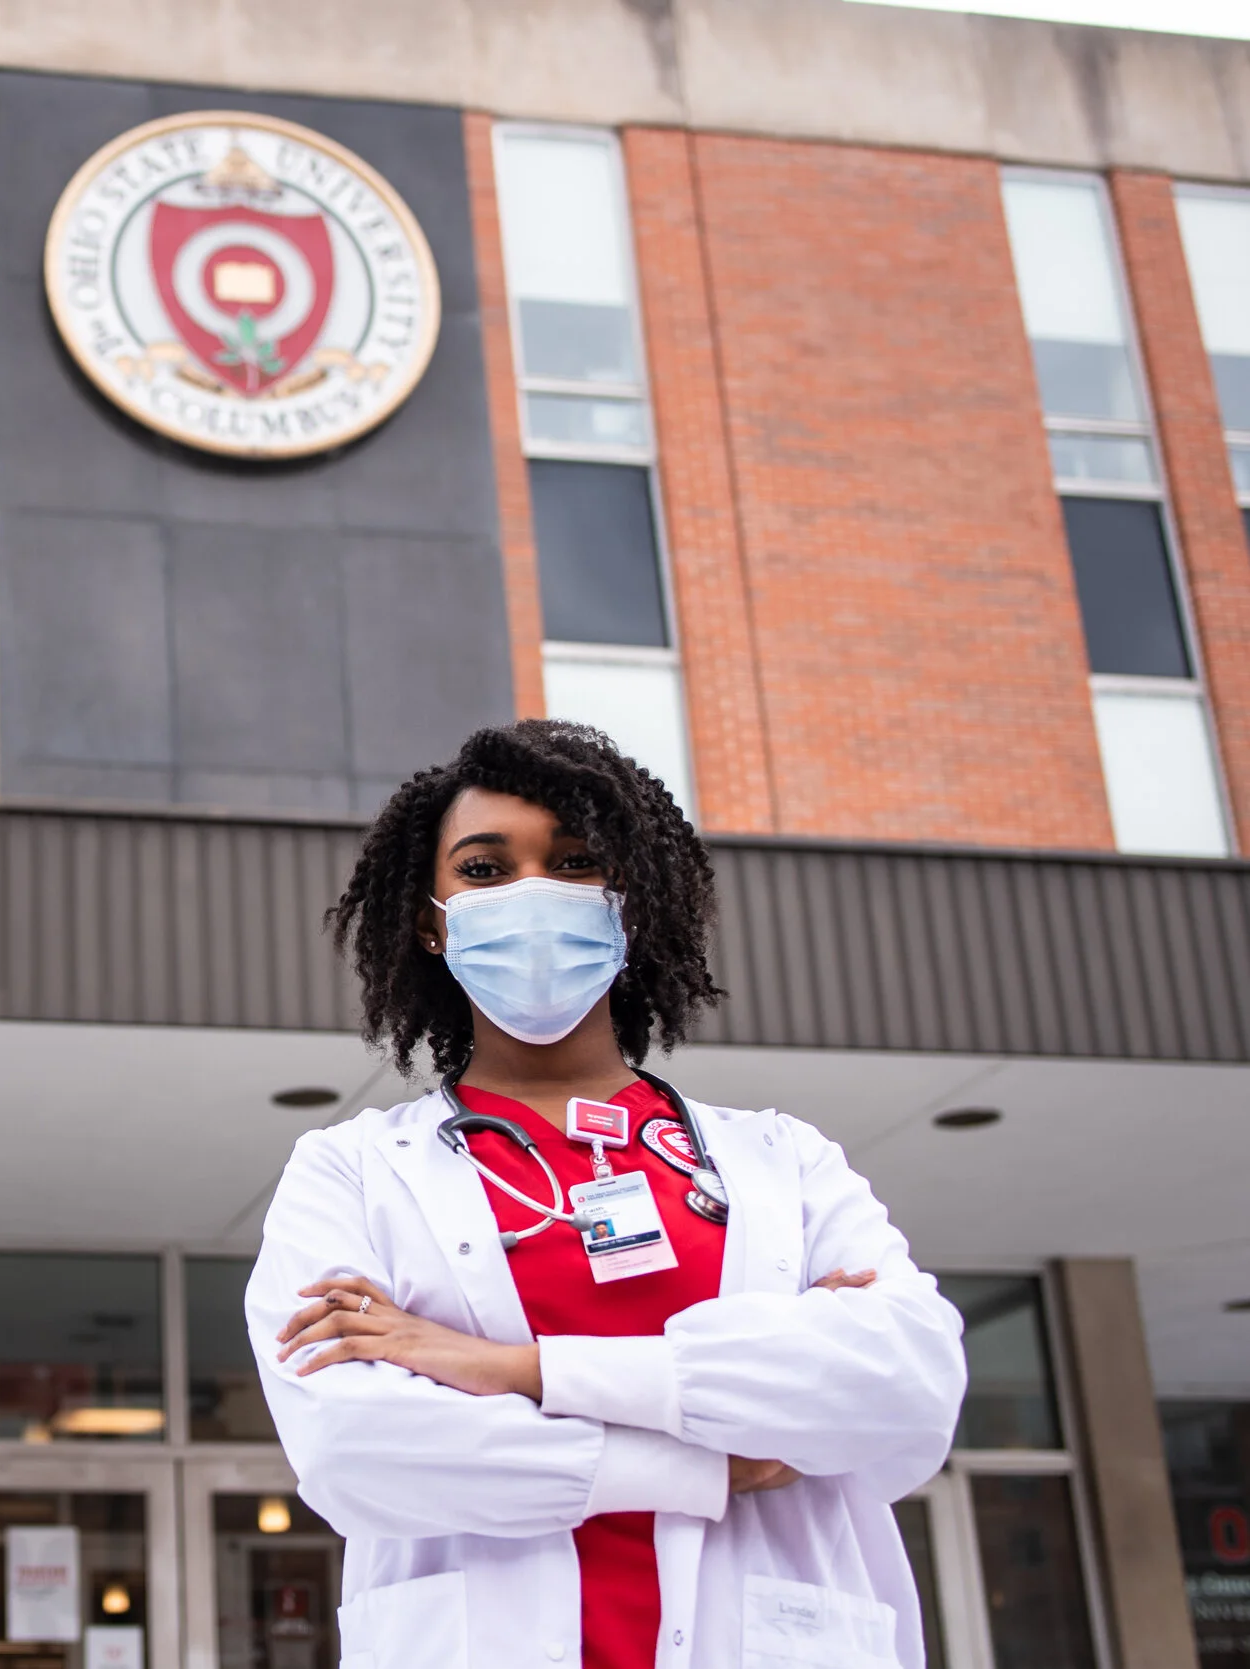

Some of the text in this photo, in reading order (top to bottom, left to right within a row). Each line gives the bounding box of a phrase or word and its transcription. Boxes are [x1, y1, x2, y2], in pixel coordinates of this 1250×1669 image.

[66, 207, 107, 312] OHIO
[101, 134, 202, 201] STATE
[276, 142, 416, 350] UNIVERSITY
[151, 386, 360, 437] COLUMBUS
[646, 1121, 662, 1145] COLLEGE
[657, 1147, 673, 1159] THE
[675, 1160, 695, 1172] OHI
